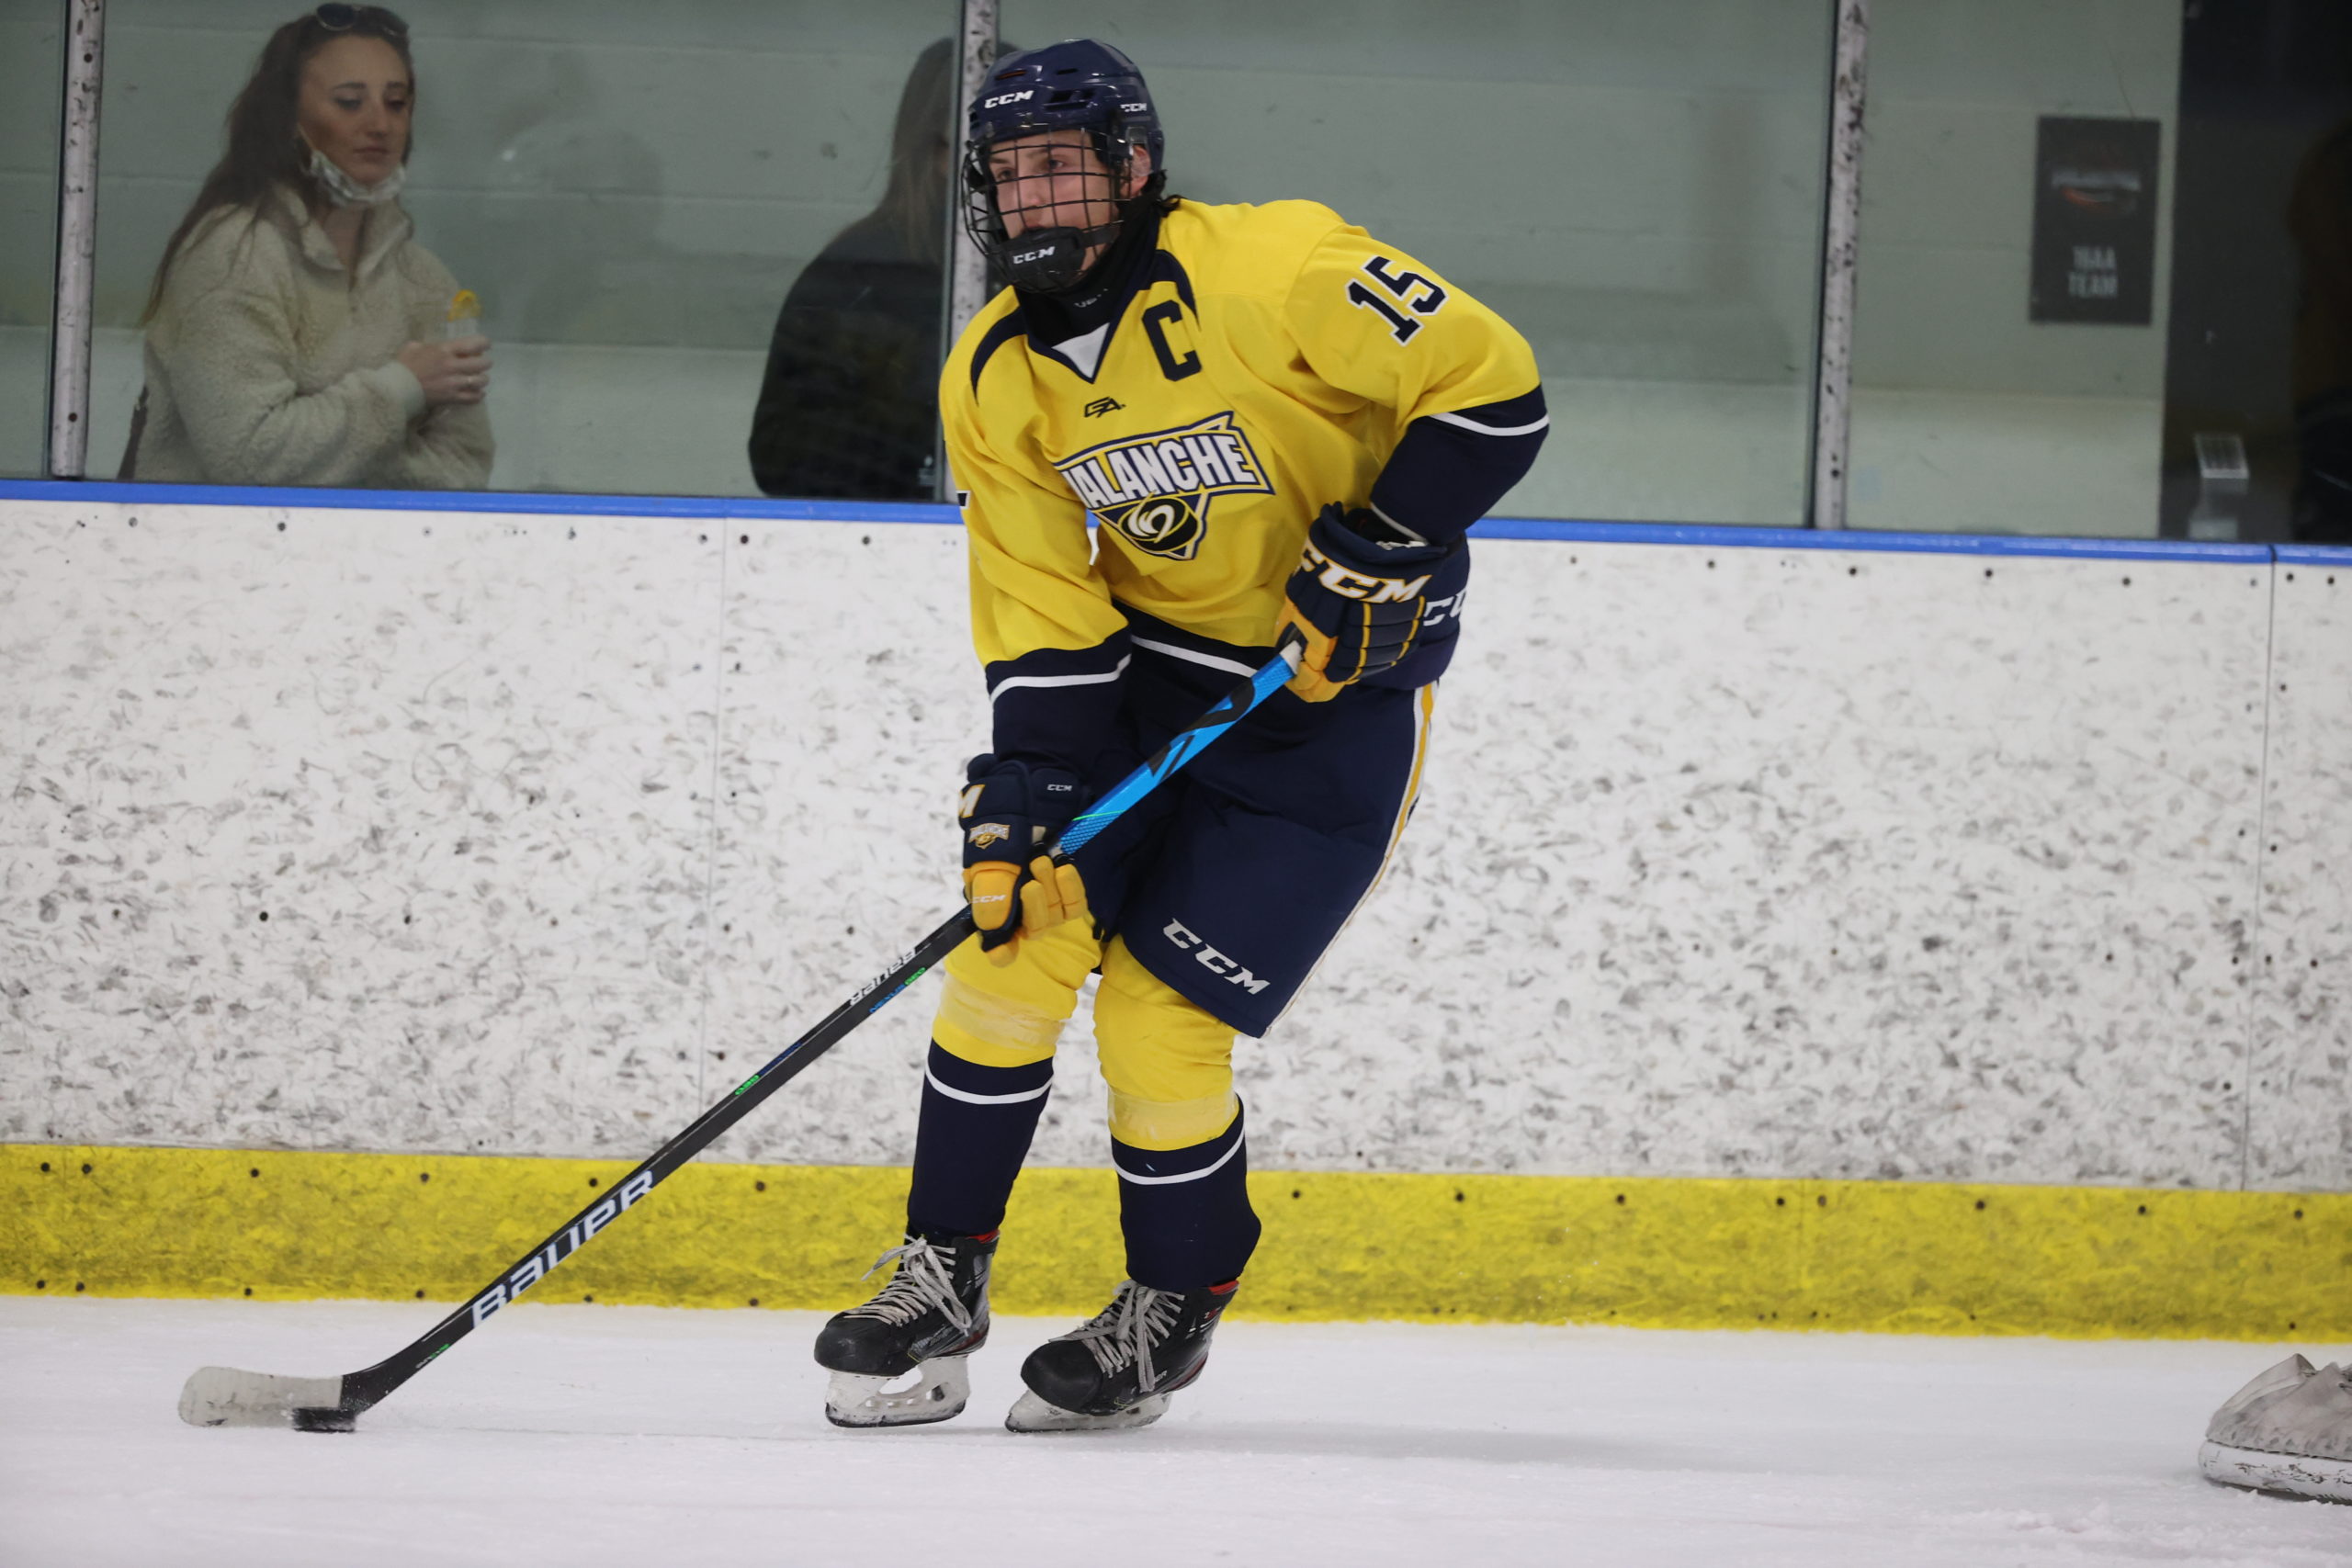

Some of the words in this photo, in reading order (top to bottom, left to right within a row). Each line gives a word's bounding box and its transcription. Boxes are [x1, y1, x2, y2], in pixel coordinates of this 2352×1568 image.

[984, 90, 1035, 109] CCM
[1120, 102, 1148, 113] CCM
[1012, 245, 1056, 265] CCM
[1345, 255, 1448, 346] 15
[1142, 299, 1202, 381] C
[1046, 784, 1073, 793] CCM
[970, 895, 1007, 904] CCM
[1162, 918, 1271, 995] CCM
